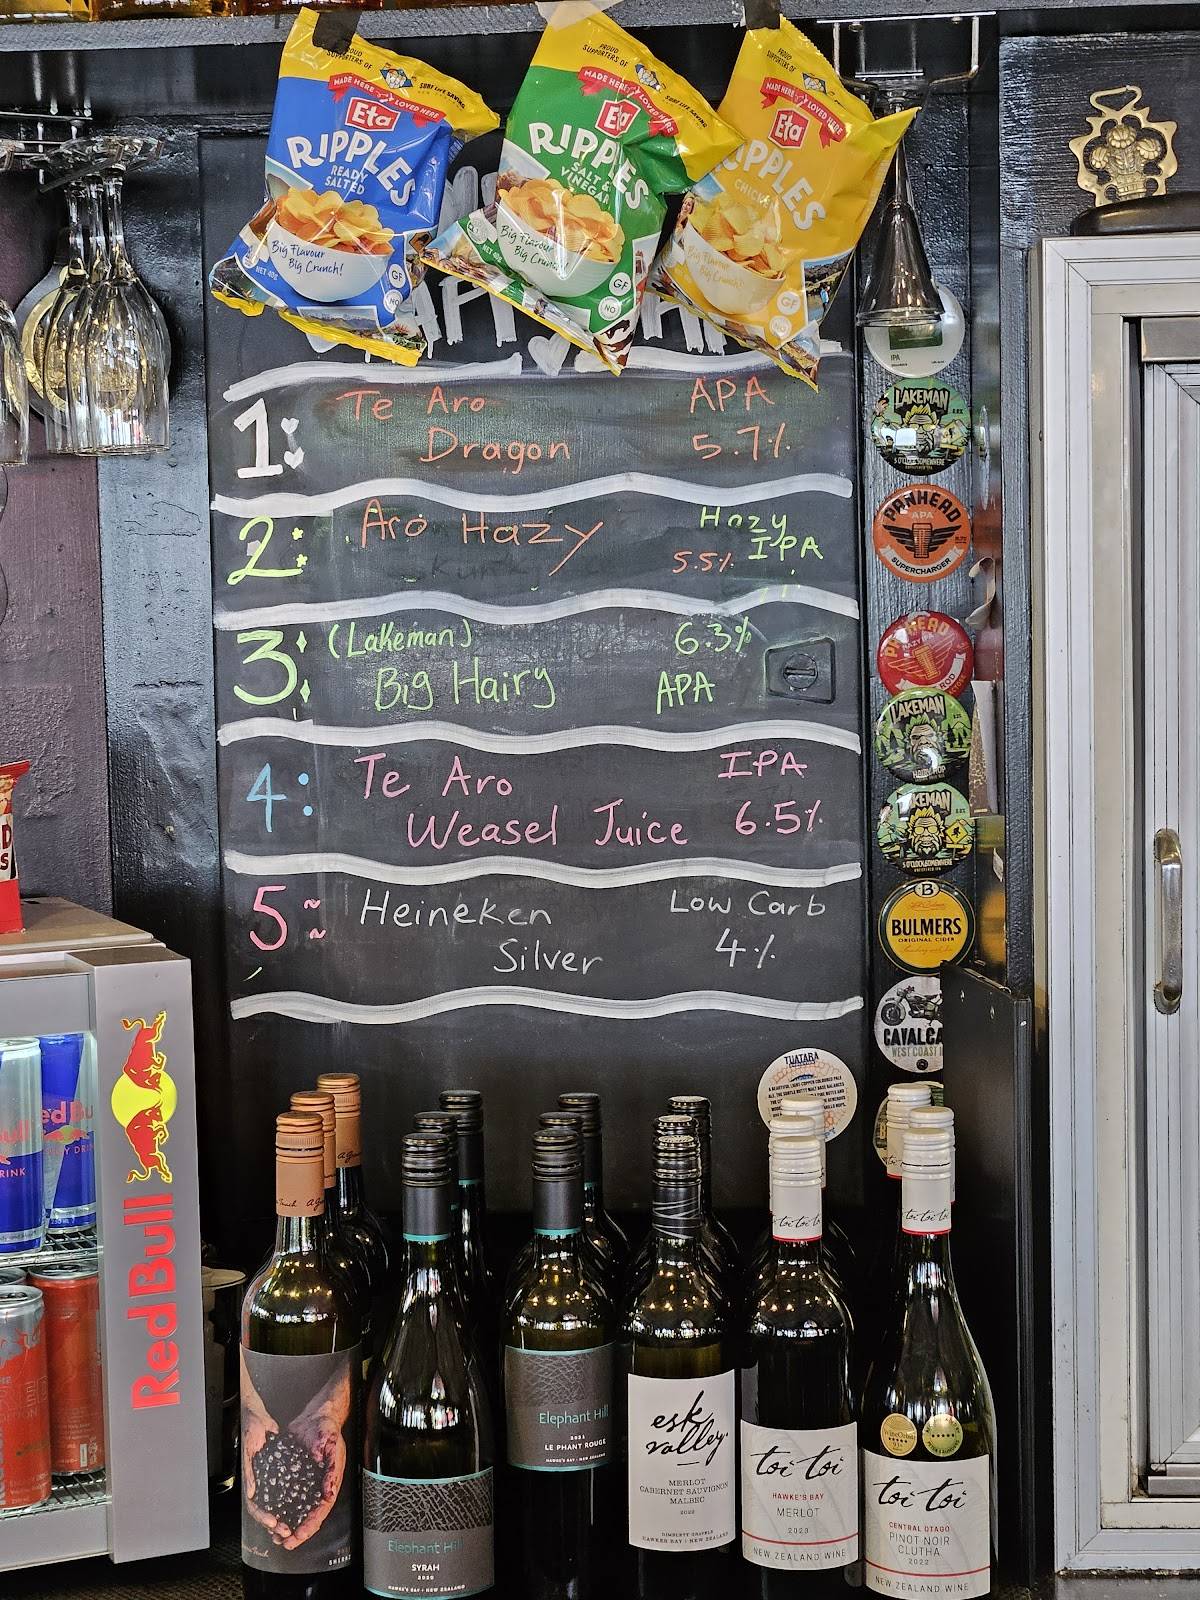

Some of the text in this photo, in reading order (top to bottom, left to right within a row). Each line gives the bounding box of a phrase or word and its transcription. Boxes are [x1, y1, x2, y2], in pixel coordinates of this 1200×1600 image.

[582, 44, 629, 68] SUPPORTERS OF
[599, 43, 620, 54] PROUD
[778, 47, 793, 60] PROUD
[364, 61, 373, 70] OF
[767, 50, 797, 73] SUPPORTERS OF
[333, 76, 440, 119] MADE HERE LOVED HERE
[419, 82, 466, 109] SURF SAVING
[584, 70, 608, 82] MADE
[639, 94, 659, 118] LOVED
[658, 113, 675, 133] HERE
[665, 95, 680, 105] SURF
[353, 102, 392, 127] Eta
[766, 82, 843, 135] MADE HERE LOVED HERE
[774, 113, 804, 142] Eta
[286, 130, 417, 206] RIPPLES
[330, 165, 369, 183] READY
[570, 161, 611, 192] SALT &
[324, 176, 365, 196] SALTED
[560, 166, 610, 205] VINEGAR
[715, 139, 826, 230] IPPLES
[500, 225, 517, 245] Big
[272, 241, 325, 258] Big Flavour
[514, 245, 530, 262] Big
[255, 266, 268, 276] NET
[288, 258, 344, 277] Big Crunch!
[391, 270, 403, 281] GF
[613, 279, 628, 290] GF
[389, 297, 400, 307] NO
[604, 304, 616, 313] NO
[781, 298, 798, 309] GF
[890, 353, 901, 361] IPA
[336, 376, 775, 421] Te Aro APA
[894, 387, 950, 409] LAKEMAN
[420, 422, 791, 475] Dragon 5.7%
[883, 490, 962, 523] PANHEAD
[911, 511, 934, 520] APA
[361, 499, 428, 548] Aro
[461, 511, 604, 576] Hazy
[672, 536, 824, 573] 5.5% IPA
[891, 556, 952, 575] SUPERCHARGER
[328, 616, 753, 659] (Lakeman) 6.3%
[375, 656, 715, 715] Big Hairy APA
[939, 673, 956, 689] ROD
[890, 696, 946, 721] LAKEMAN
[354, 750, 808, 799] Te Aro IPA
[407, 798, 824, 850] Weasel Juice 6.5%
[922, 884, 933, 895] B
[747, 891, 826, 917] Carb
[891, 918, 961, 936] BULMERS
[494, 938, 603, 975] Silver
[784, 1051, 819, 1065] TUATARA
[892, 1045, 937, 1057] WEST COAST
[41, 1101, 66, 1124] ed
[123, 1193, 180, 1409] Red Bull
[539, 1404, 609, 1429] Elephant Hill
[651, 1390, 714, 1432] esk
[556, 1443, 583, 1451] PHANT
[584, 1438, 606, 1448] ROUGE
[750, 1445, 844, 1480] toi toi
[640, 1481, 729, 1496] CABERNET SAUVIGNON
[668, 1478, 706, 1487] MERLOT
[669, 1496, 705, 1505] MALBEC
[772, 1492, 808, 1500] HAWKE'S
[872, 1475, 967, 1512] toi toi
[777, 1507, 821, 1518] MERLOT
[888, 1521, 950, 1533] CENTRAL OTAGO
[388, 1538, 464, 1556] Elephant Hill
[889, 1532, 950, 1546] PINOT NOIR
[753, 1547, 846, 1561] NEW ZEALAND WINE
[898, 1545, 941, 1557] CLUTHA
[411, 1563, 440, 1571] SYRAH
[439, 1584, 466, 1592] ZEALAND
[875, 1575, 969, 1593] NEW ZEALAND WINE
